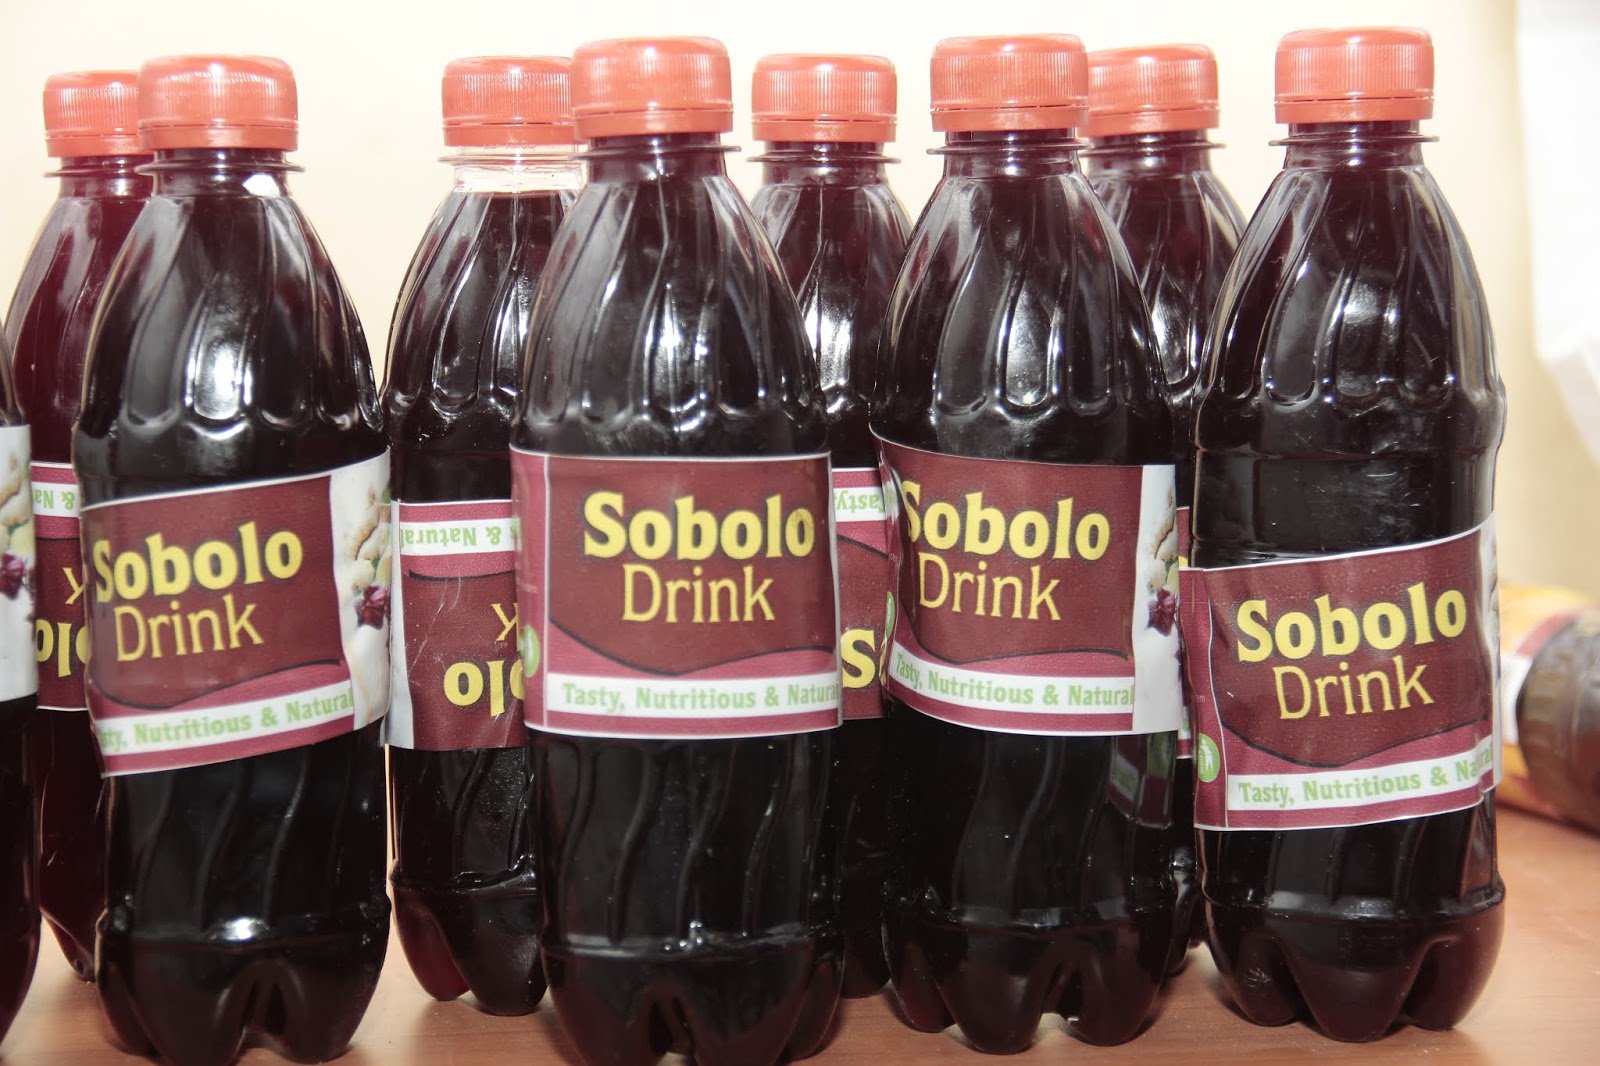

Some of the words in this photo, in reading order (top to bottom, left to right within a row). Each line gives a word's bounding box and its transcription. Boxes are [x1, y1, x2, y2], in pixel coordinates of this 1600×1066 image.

[583, 491, 816, 561] Sobolo
[901, 480, 1111, 561] Sobolo
[92, 521, 304, 604] Sobolo
[622, 563, 776, 623] Drink
[918, 551, 1061, 621] Drink
[112, 593, 264, 662] Drink
[1236, 581, 1468, 664] Sobolo
[133, 713, 252, 746] Nutritious
[259, 705, 280, 729] &
[285, 686, 354, 725] Natural
[562, 682, 626, 713] Tasty,
[635, 685, 757, 711] Nutritious
[763, 684, 781, 709] &
[928, 669, 1036, 706] Nutritious
[1041, 683, 1061, 707] &
[1067, 683, 1135, 707] Natural
[1271, 655, 1435, 720] Drink
[1237, 781, 1296, 809] Tasty,
[1302, 773, 1424, 802] Nutritious
[1430, 764, 1450, 788] &
